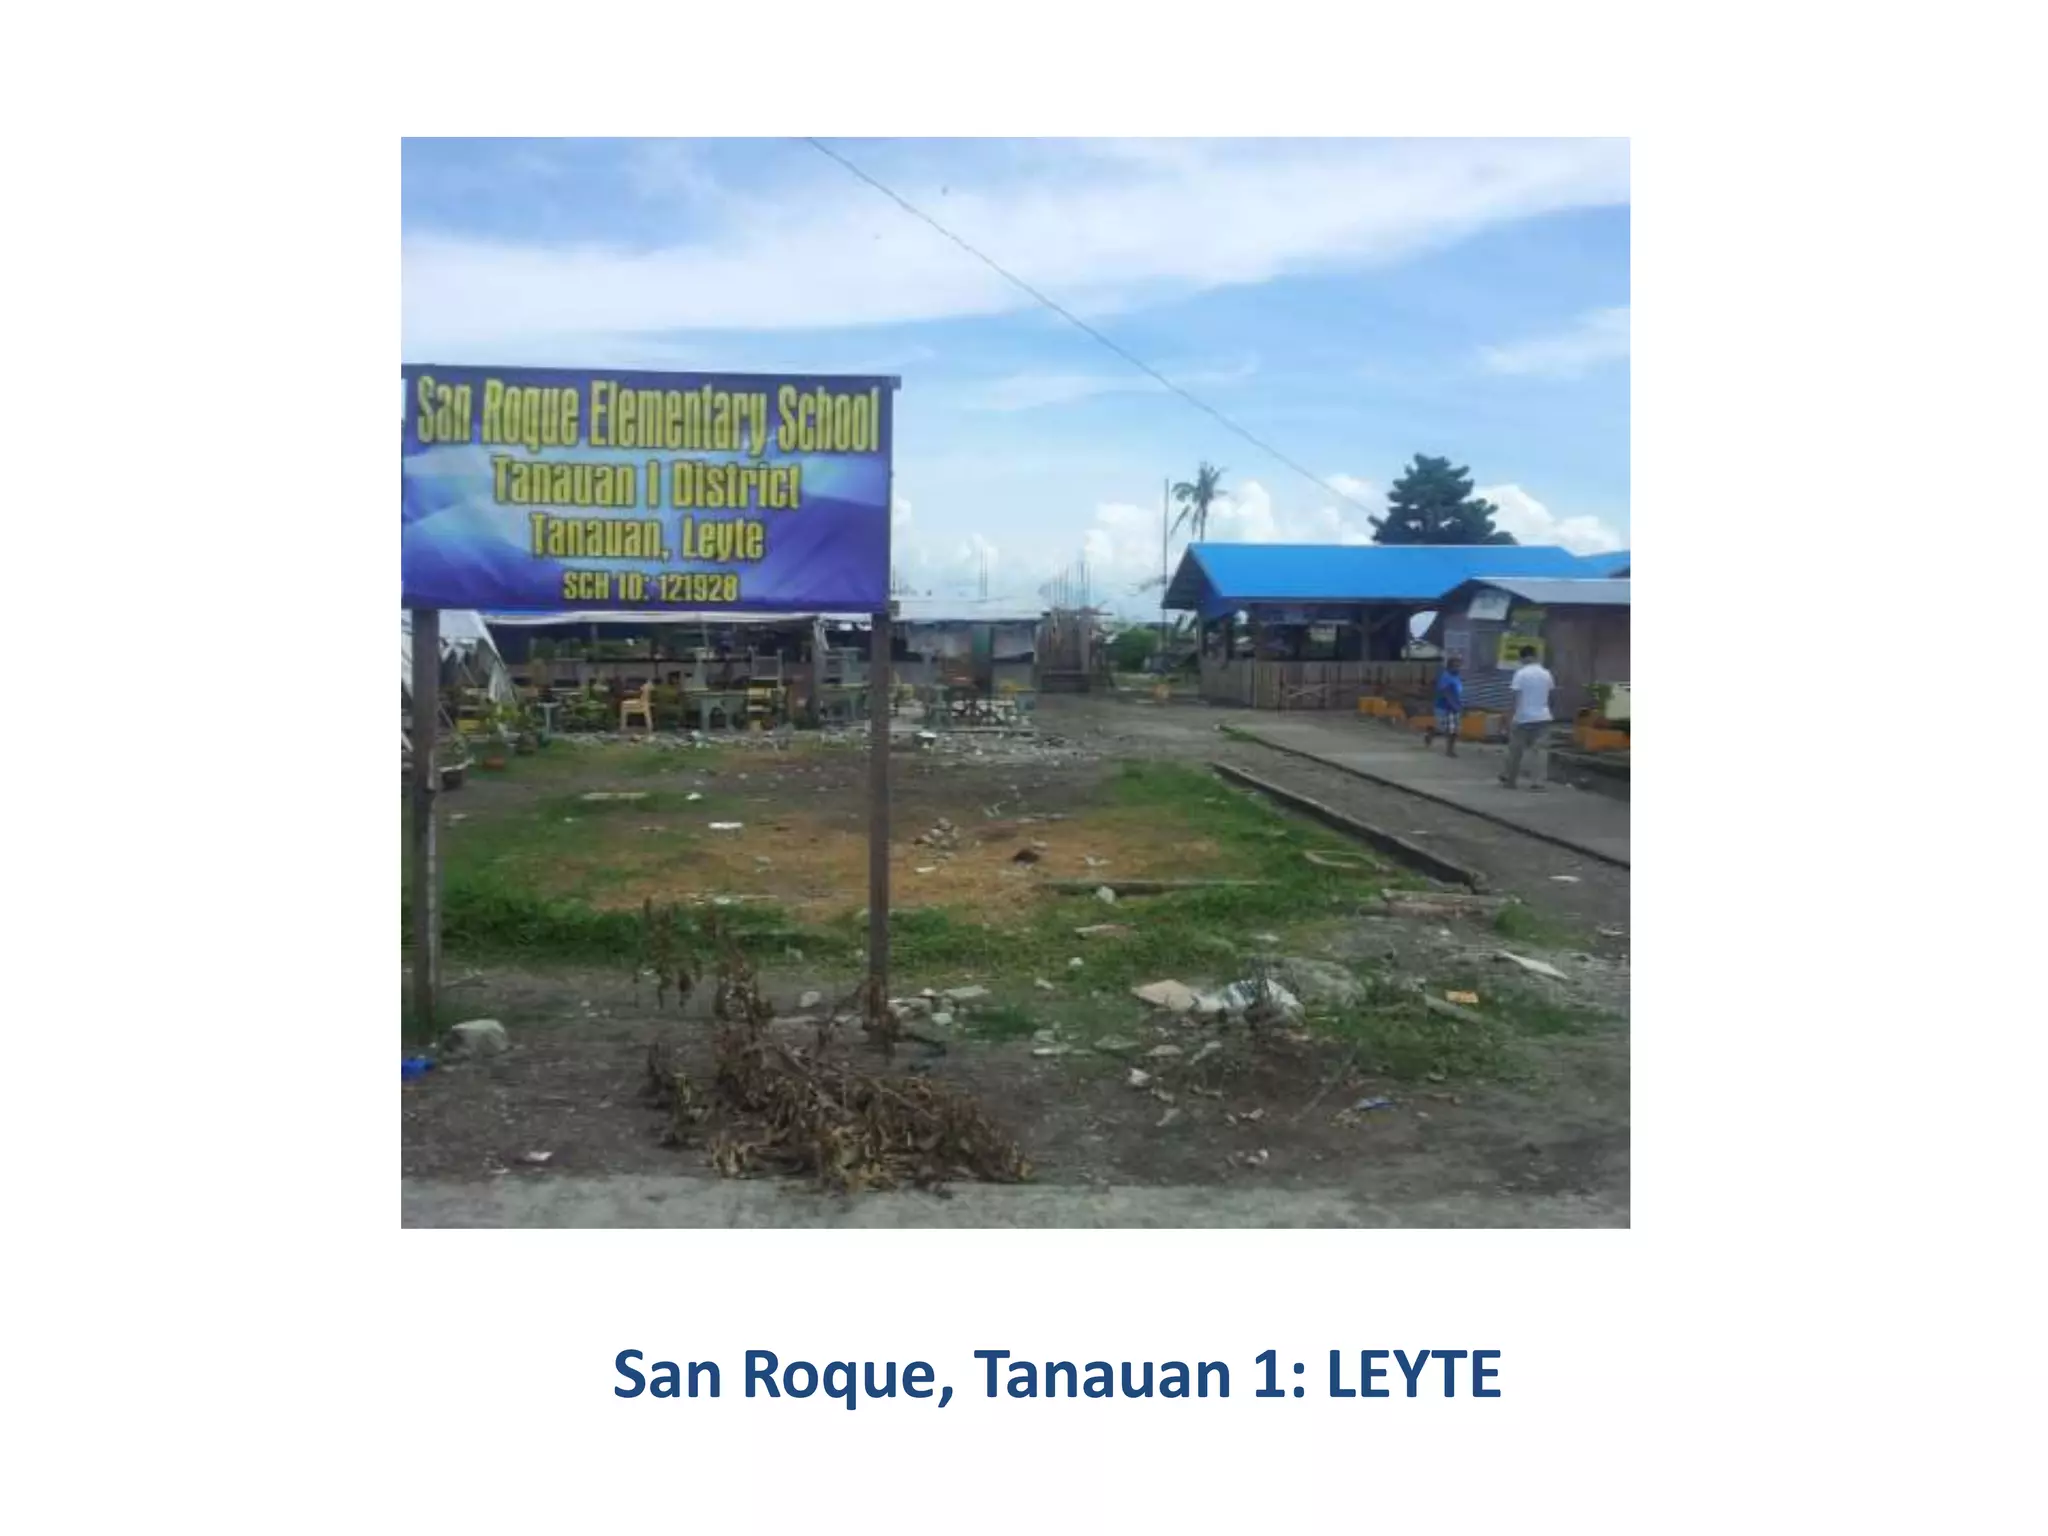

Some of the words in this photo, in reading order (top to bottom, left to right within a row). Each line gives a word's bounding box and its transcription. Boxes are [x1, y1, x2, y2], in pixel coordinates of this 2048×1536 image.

[416, 375, 472, 445] San
[482, 379, 580, 453] Roque
[590, 380, 768, 457] Elementary
[778, 384, 881, 453] School
[493, 455, 636, 506] Tanauan
[671, 462, 801, 510] District
[531, 514, 670, 561] Tanauan,
[682, 518, 764, 563] Leyte
[563, 571, 610, 600] SCH
[616, 572, 650, 601] ID:
